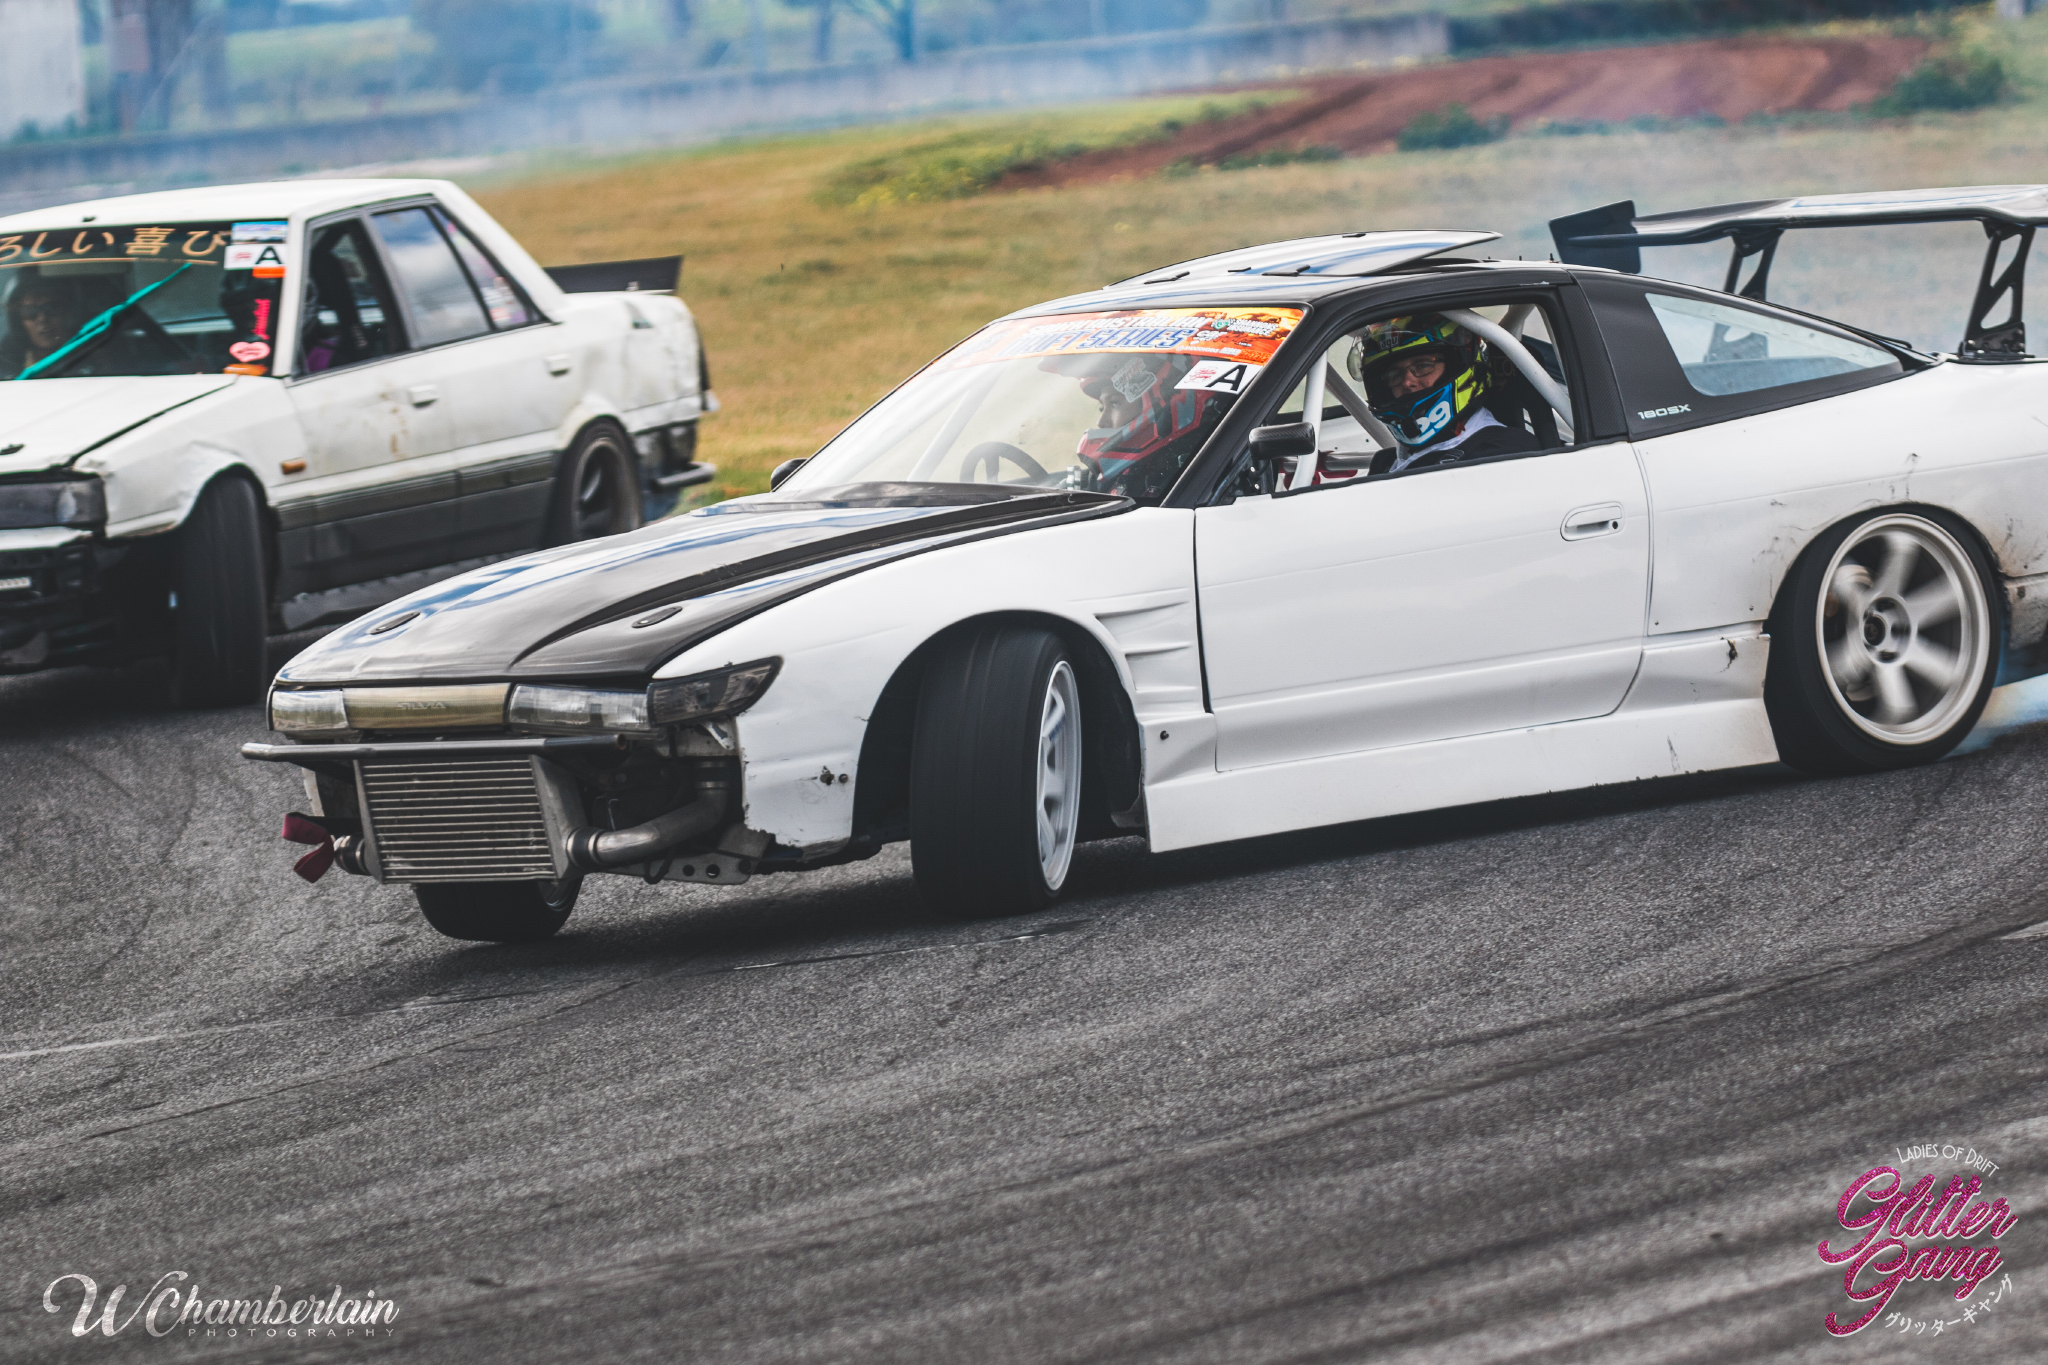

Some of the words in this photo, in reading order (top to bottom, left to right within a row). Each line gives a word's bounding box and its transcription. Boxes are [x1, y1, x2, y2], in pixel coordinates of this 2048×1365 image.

[255, 246, 283, 265] A
[1084, 316, 1213, 331] AUSTRALIAN
[1076, 327, 1199, 349] SERIES
[1205, 364, 1248, 392] A
[1637, 403, 1692, 420] 180SX
